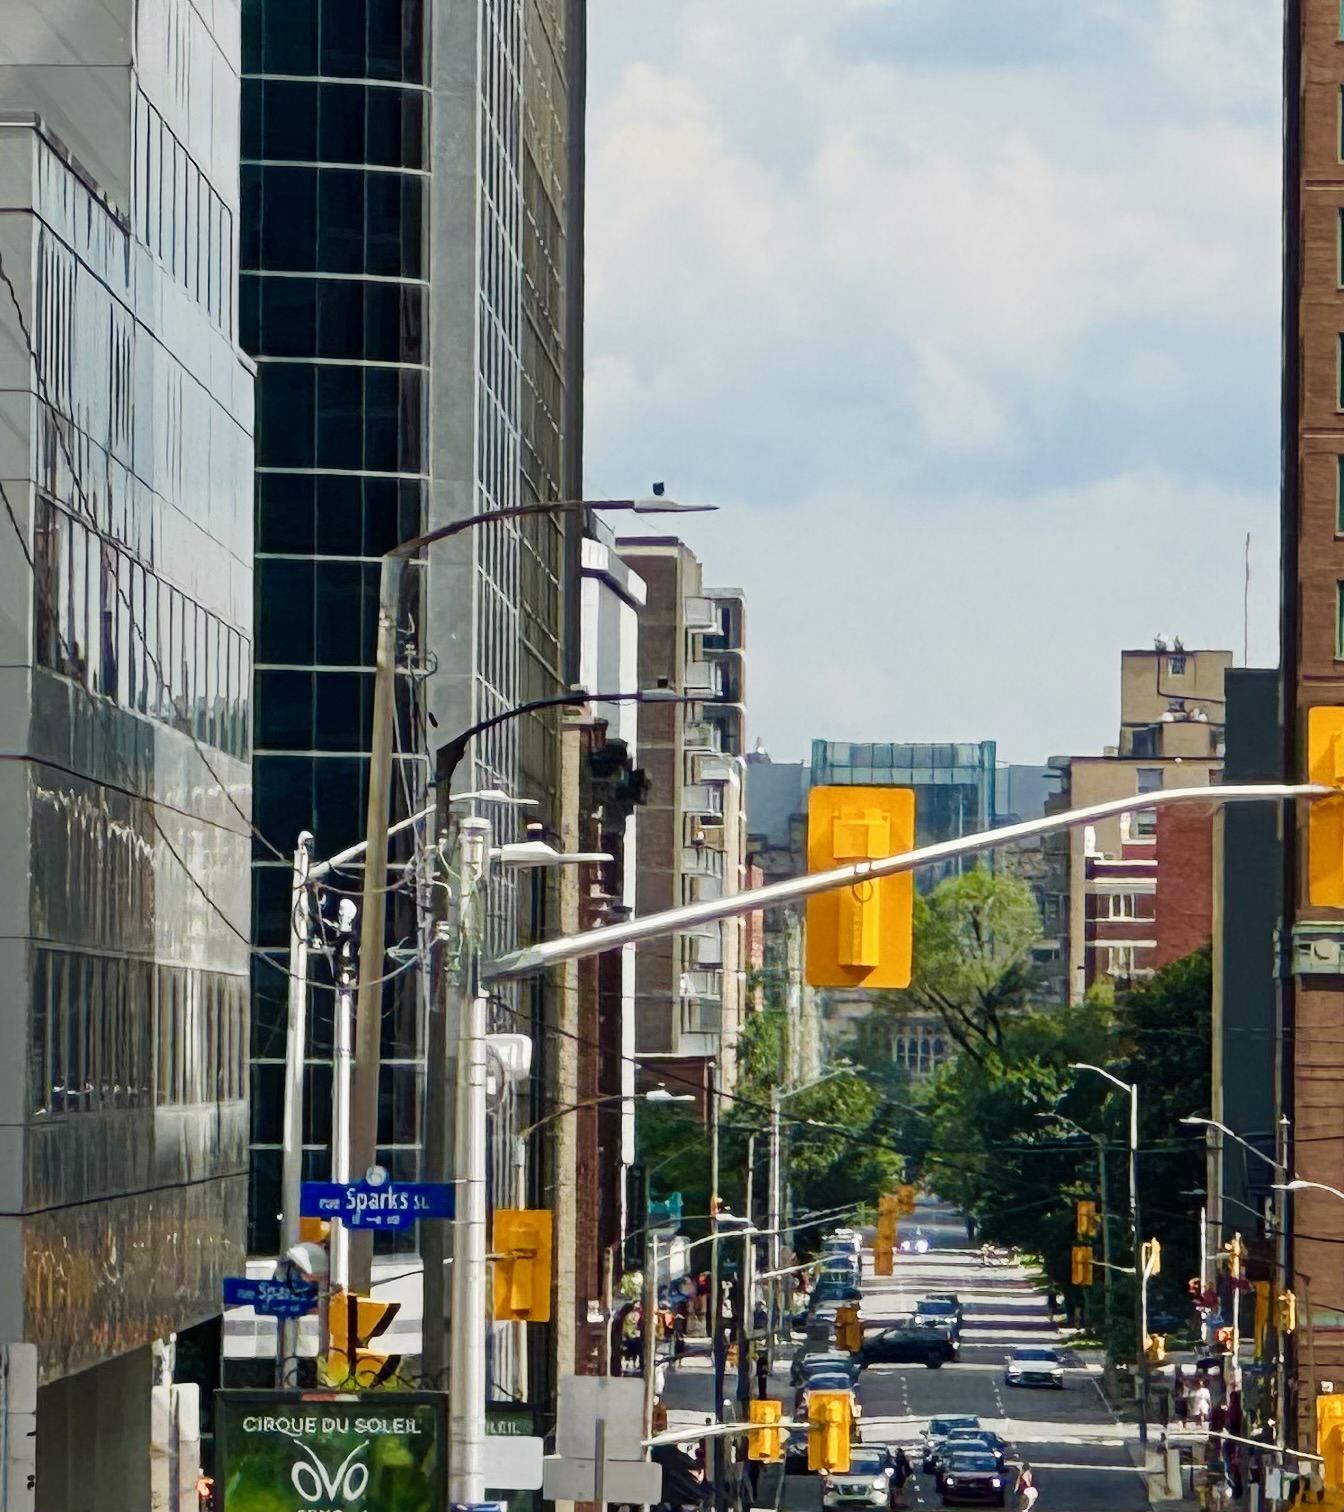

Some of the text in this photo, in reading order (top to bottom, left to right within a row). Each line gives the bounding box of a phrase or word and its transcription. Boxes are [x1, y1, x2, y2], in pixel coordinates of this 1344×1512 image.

[346, 1185, 408, 1214] Sparks
[243, 1417, 421, 1437] CIRQUE DU SOLEIL
